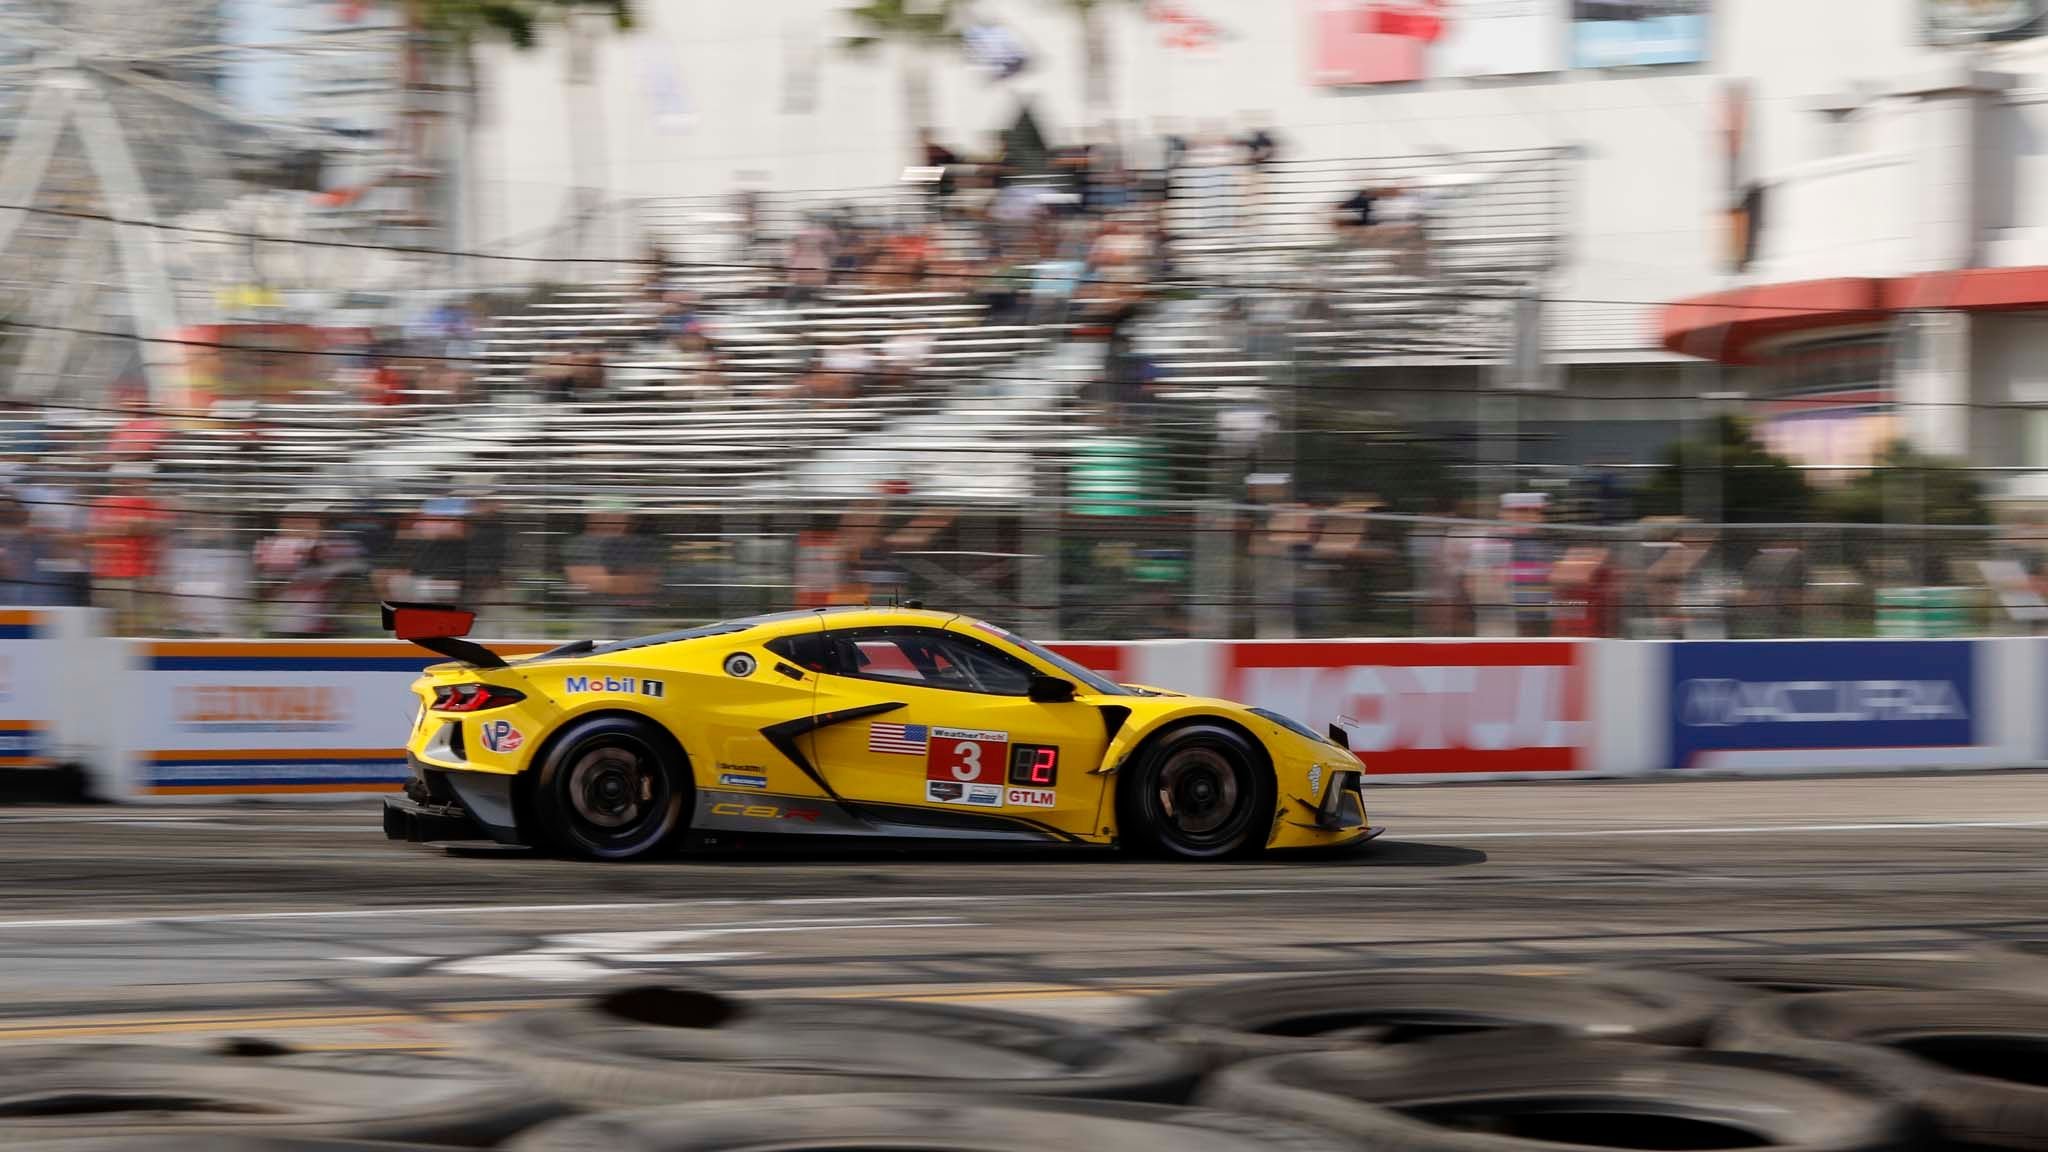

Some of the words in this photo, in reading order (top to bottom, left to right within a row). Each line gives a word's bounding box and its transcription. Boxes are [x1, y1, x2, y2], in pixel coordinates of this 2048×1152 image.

[566, 676, 635, 693] Mobil
[483, 720, 511, 751] VP
[933, 728, 1005, 741] WeatherTech
[951, 741, 982, 781] 3
[1031, 749, 1056, 782] 2
[1008, 790, 1054, 805] GTLM
